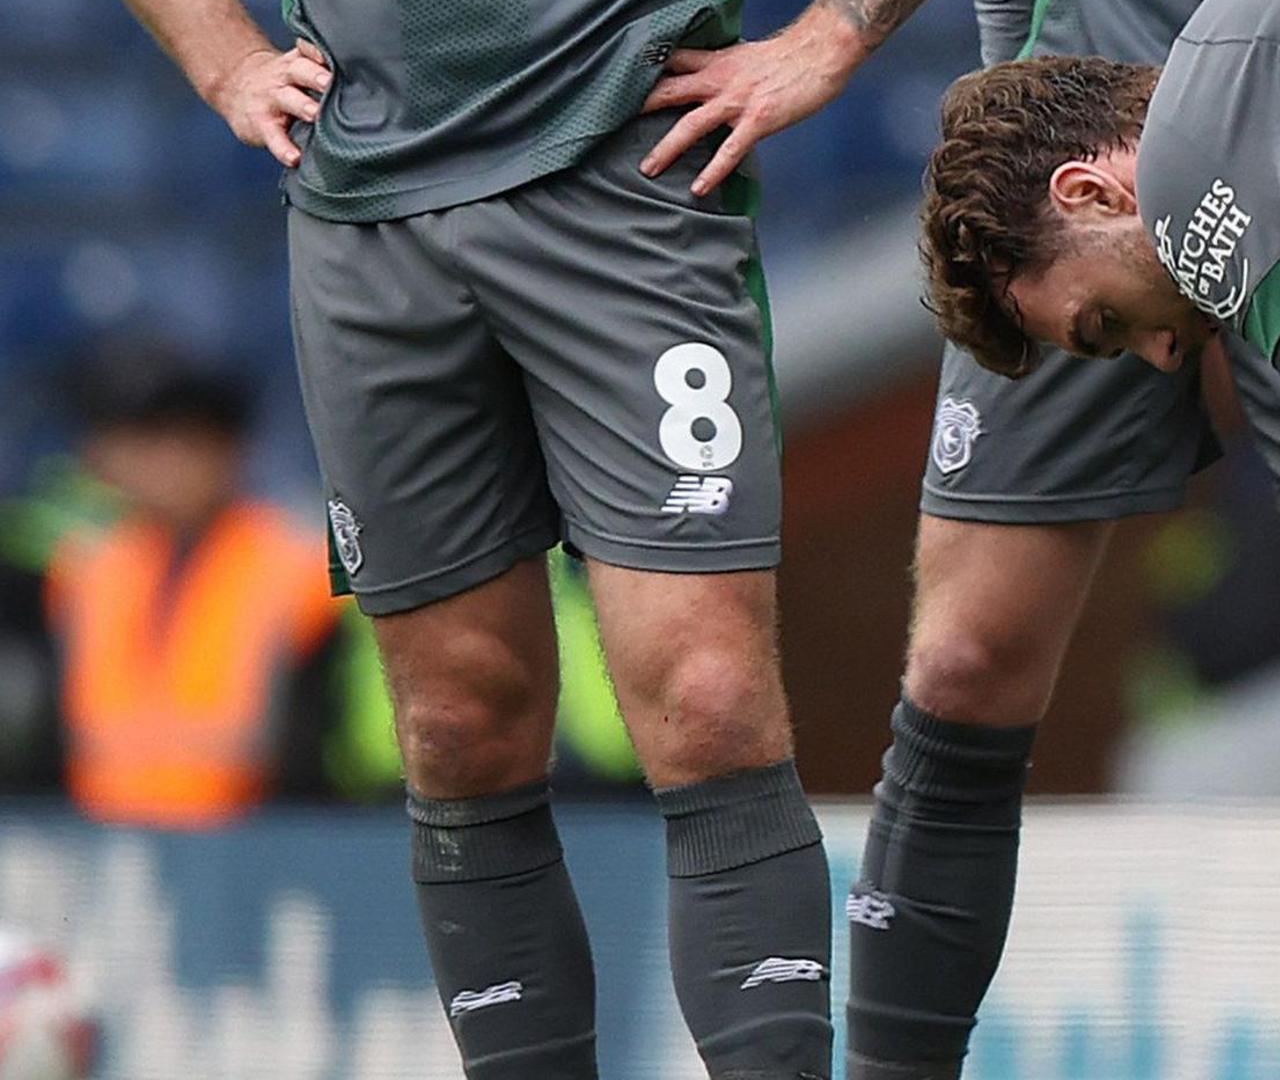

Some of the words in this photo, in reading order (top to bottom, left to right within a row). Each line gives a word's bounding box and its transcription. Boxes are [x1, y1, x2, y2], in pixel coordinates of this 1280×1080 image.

[1178, 179, 1235, 298] ATCHES
[1201, 204, 1252, 284] BATH
[654, 342, 742, 471] 8
